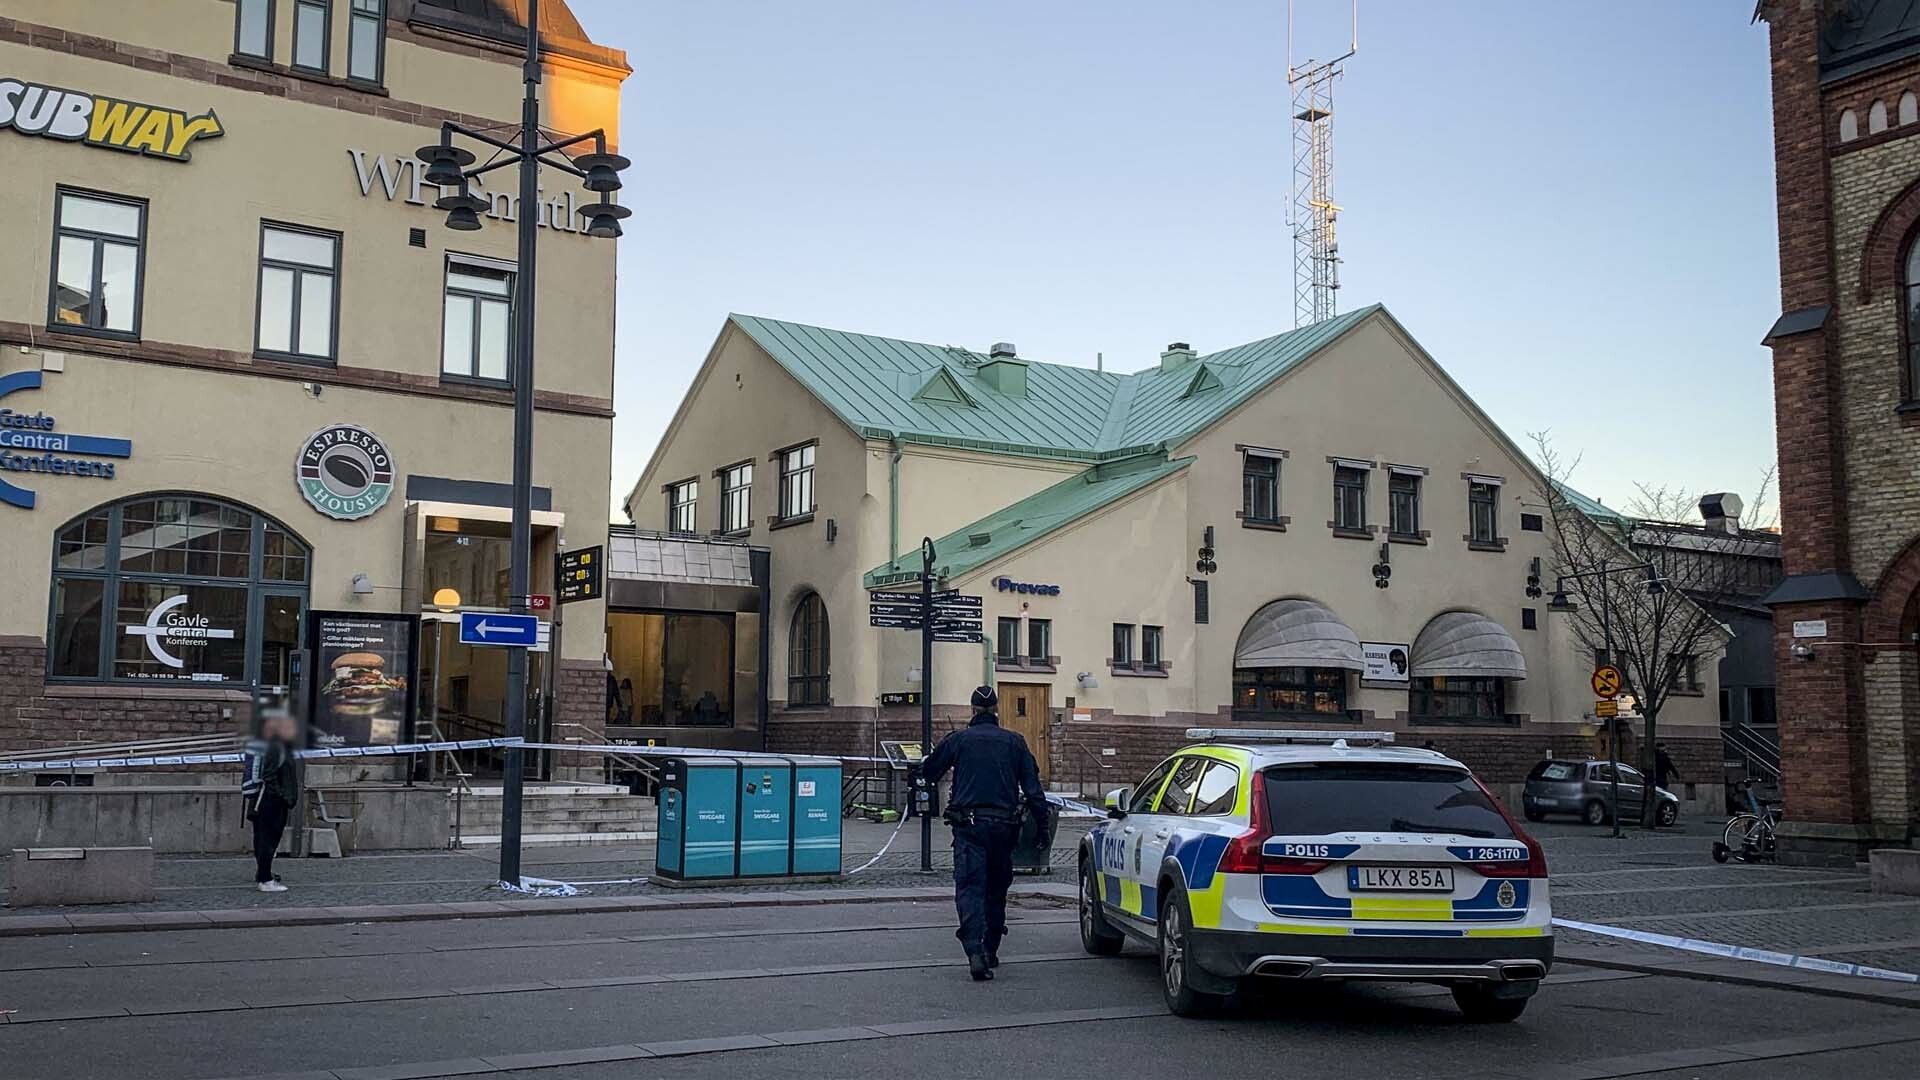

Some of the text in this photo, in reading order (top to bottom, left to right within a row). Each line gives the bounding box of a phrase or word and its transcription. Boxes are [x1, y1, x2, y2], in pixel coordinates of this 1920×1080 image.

[0, 80, 220, 156] SUBWAY
[0, 429, 69, 451] Central
[306, 429, 387, 467] ESPRESSO
[313, 488, 378, 512] HOUSE
[998, 578, 1061, 596] Prevas
[166, 637, 208, 646] Konferens
[1105, 837, 1125, 870] POLIS
[1285, 844, 1329, 857] POLIS
[1478, 848, 1521, 860] 26-1170
[1365, 868, 1446, 888] LKX 85A
